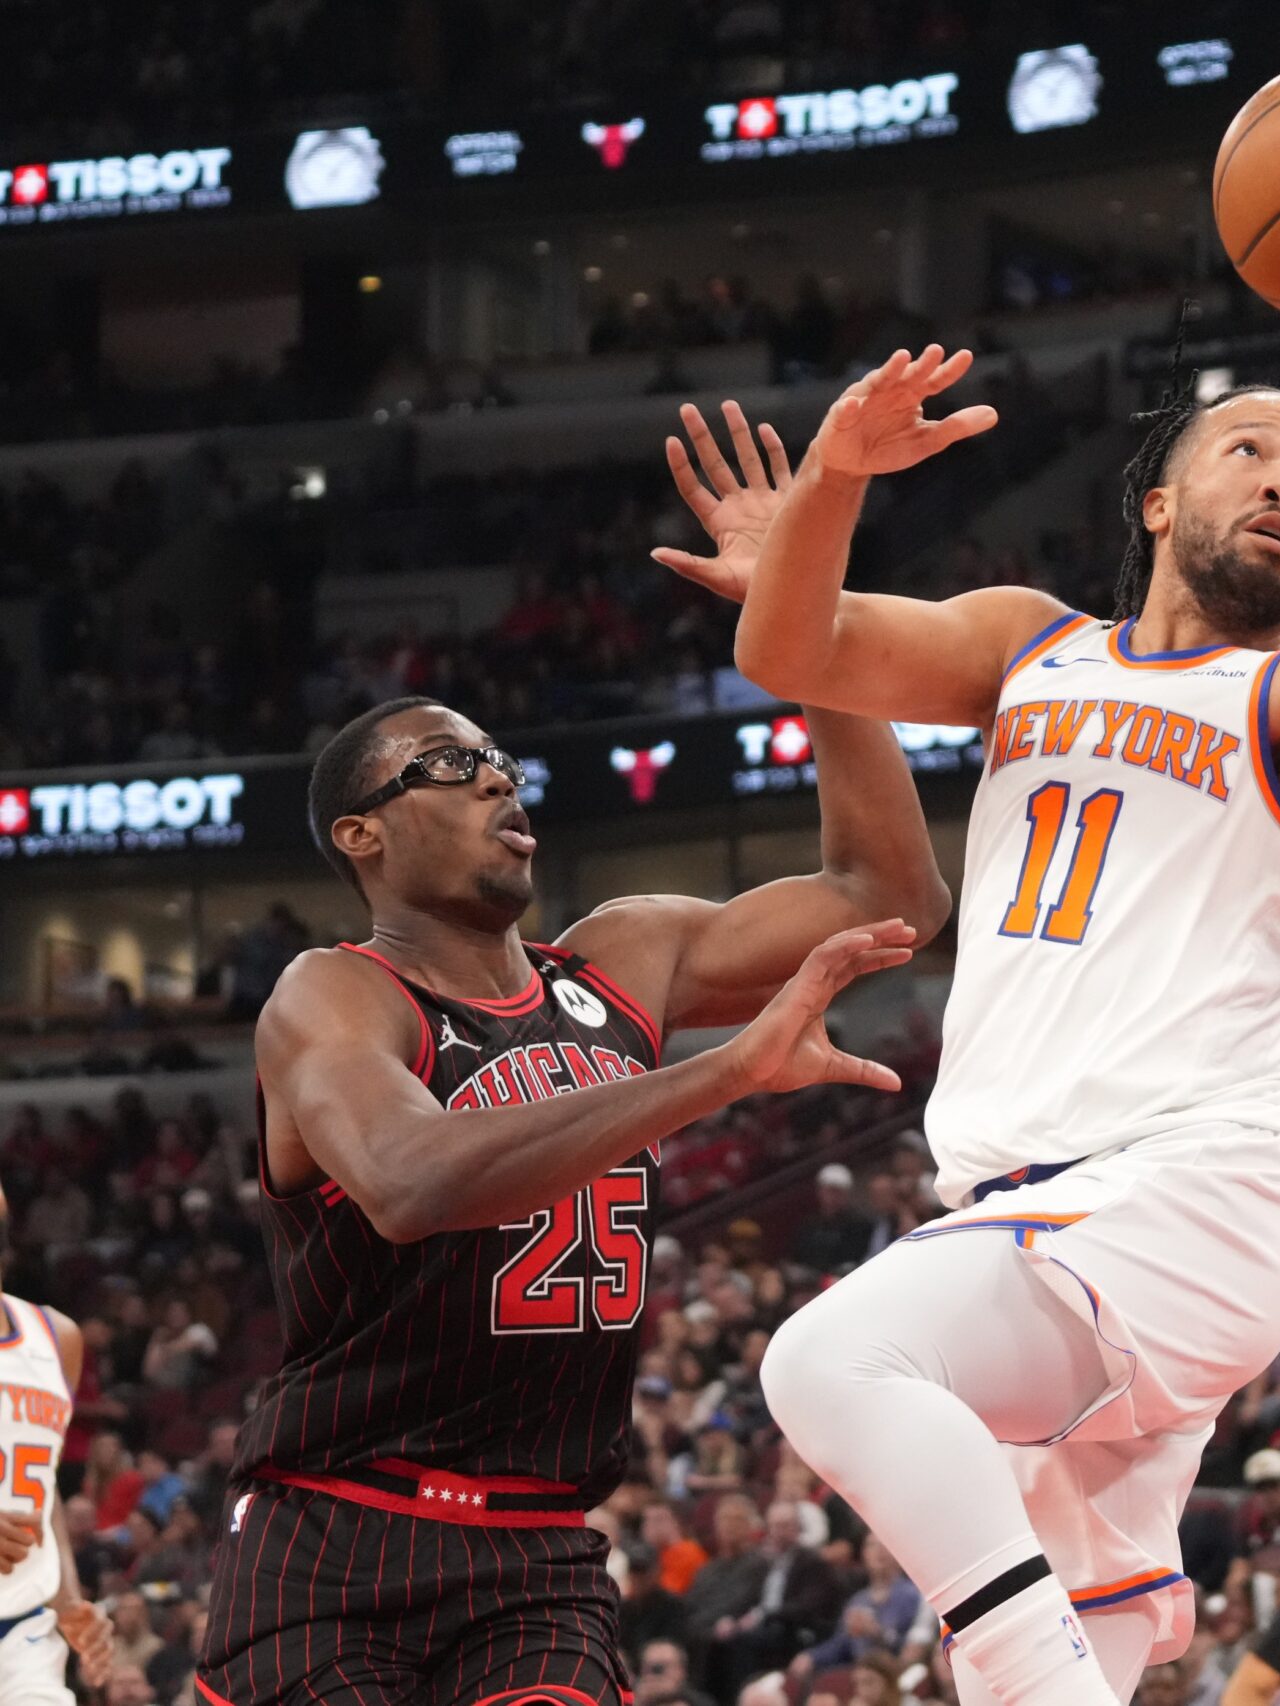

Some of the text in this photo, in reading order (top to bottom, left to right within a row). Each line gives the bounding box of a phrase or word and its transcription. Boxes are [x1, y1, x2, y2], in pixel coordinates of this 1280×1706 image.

[776, 72, 959, 138] TISSOT
[48, 147, 232, 202] TISSOT
[989, 700, 1245, 806] NEW YORK
[30, 773, 245, 836] TISSOT
[997, 780, 1125, 947] 11
[491, 1167, 648, 1335] 25
